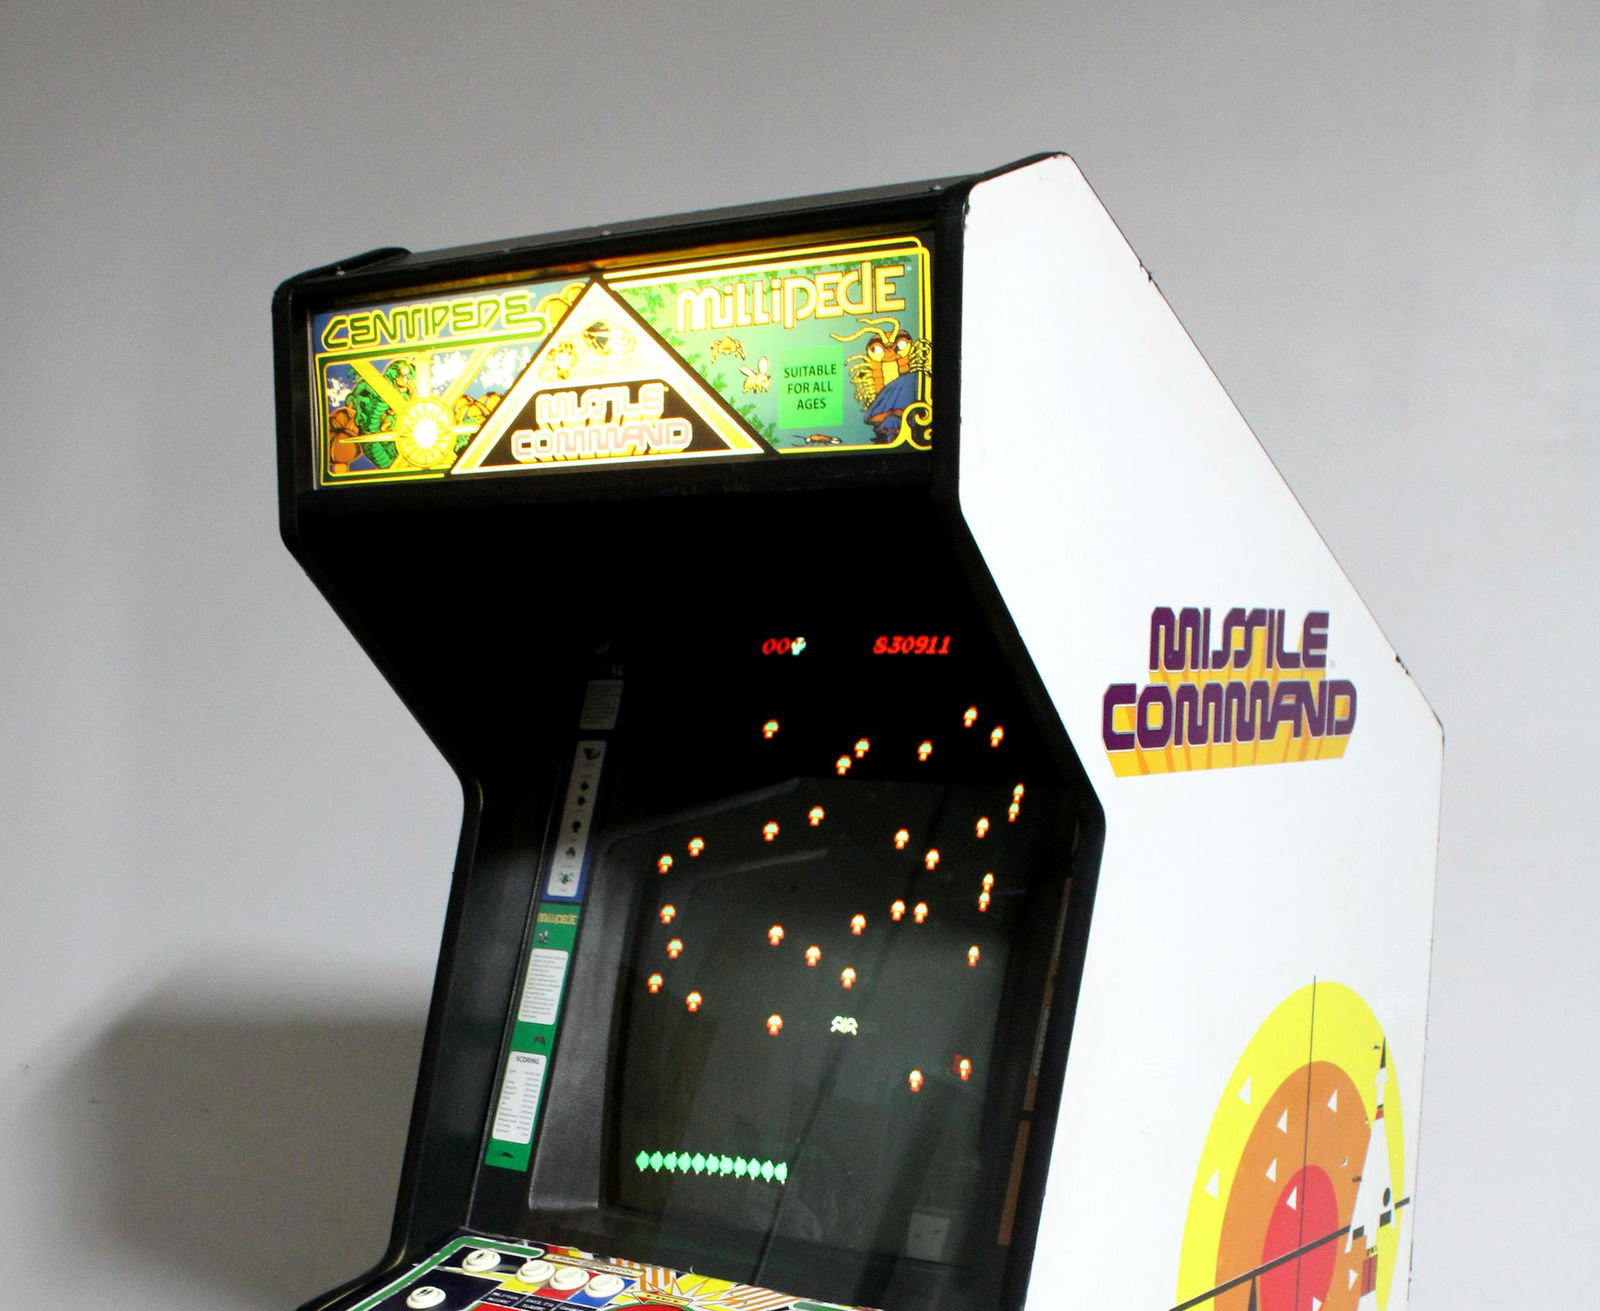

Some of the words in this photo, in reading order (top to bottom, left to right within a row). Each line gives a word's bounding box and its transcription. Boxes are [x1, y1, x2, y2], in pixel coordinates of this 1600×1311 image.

[322, 291, 546, 351] CENTIPEDE
[783, 364, 837, 378] SUITABLE
[787, 383, 810, 395] FOR
[812, 382, 834, 393] ALL
[535, 383, 665, 426] MISSILE
[796, 398, 827, 410] AGES
[511, 418, 692, 461] COMMAND
[872, 635, 951, 655] 830911
[1149, 607, 1330, 673] MISSILE
[1102, 679, 1357, 753] COMMAND
